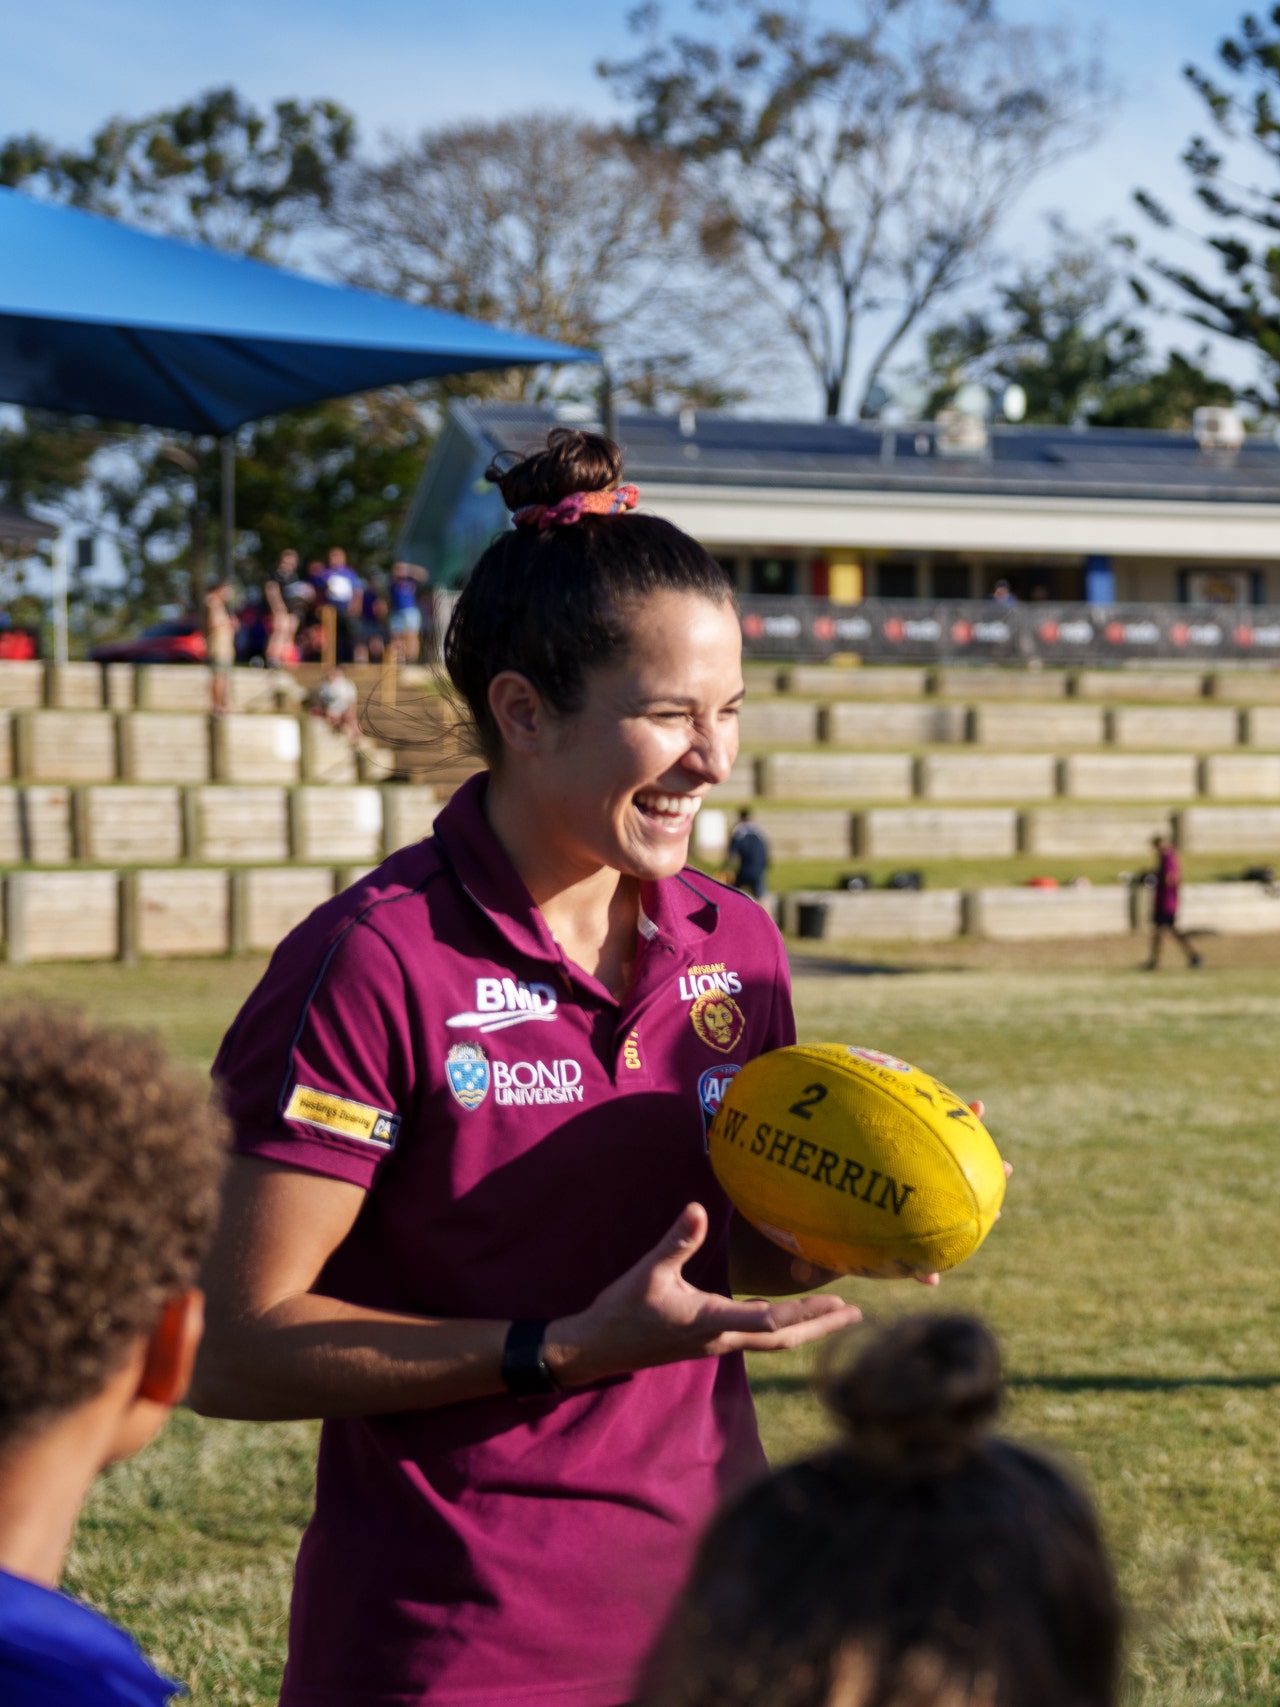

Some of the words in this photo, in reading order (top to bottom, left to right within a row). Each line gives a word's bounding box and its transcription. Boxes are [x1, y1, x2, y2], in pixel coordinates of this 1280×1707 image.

[687, 962, 727, 976] BRISBANE
[476, 978, 557, 1014] BMD
[679, 971, 742, 1000] LIONS
[492, 1059, 582, 1088] BOND
[495, 1085, 583, 1105] UNIVERSITY
[790, 1082, 828, 1121] 2
[750, 1122, 916, 1216] SHERRIN
